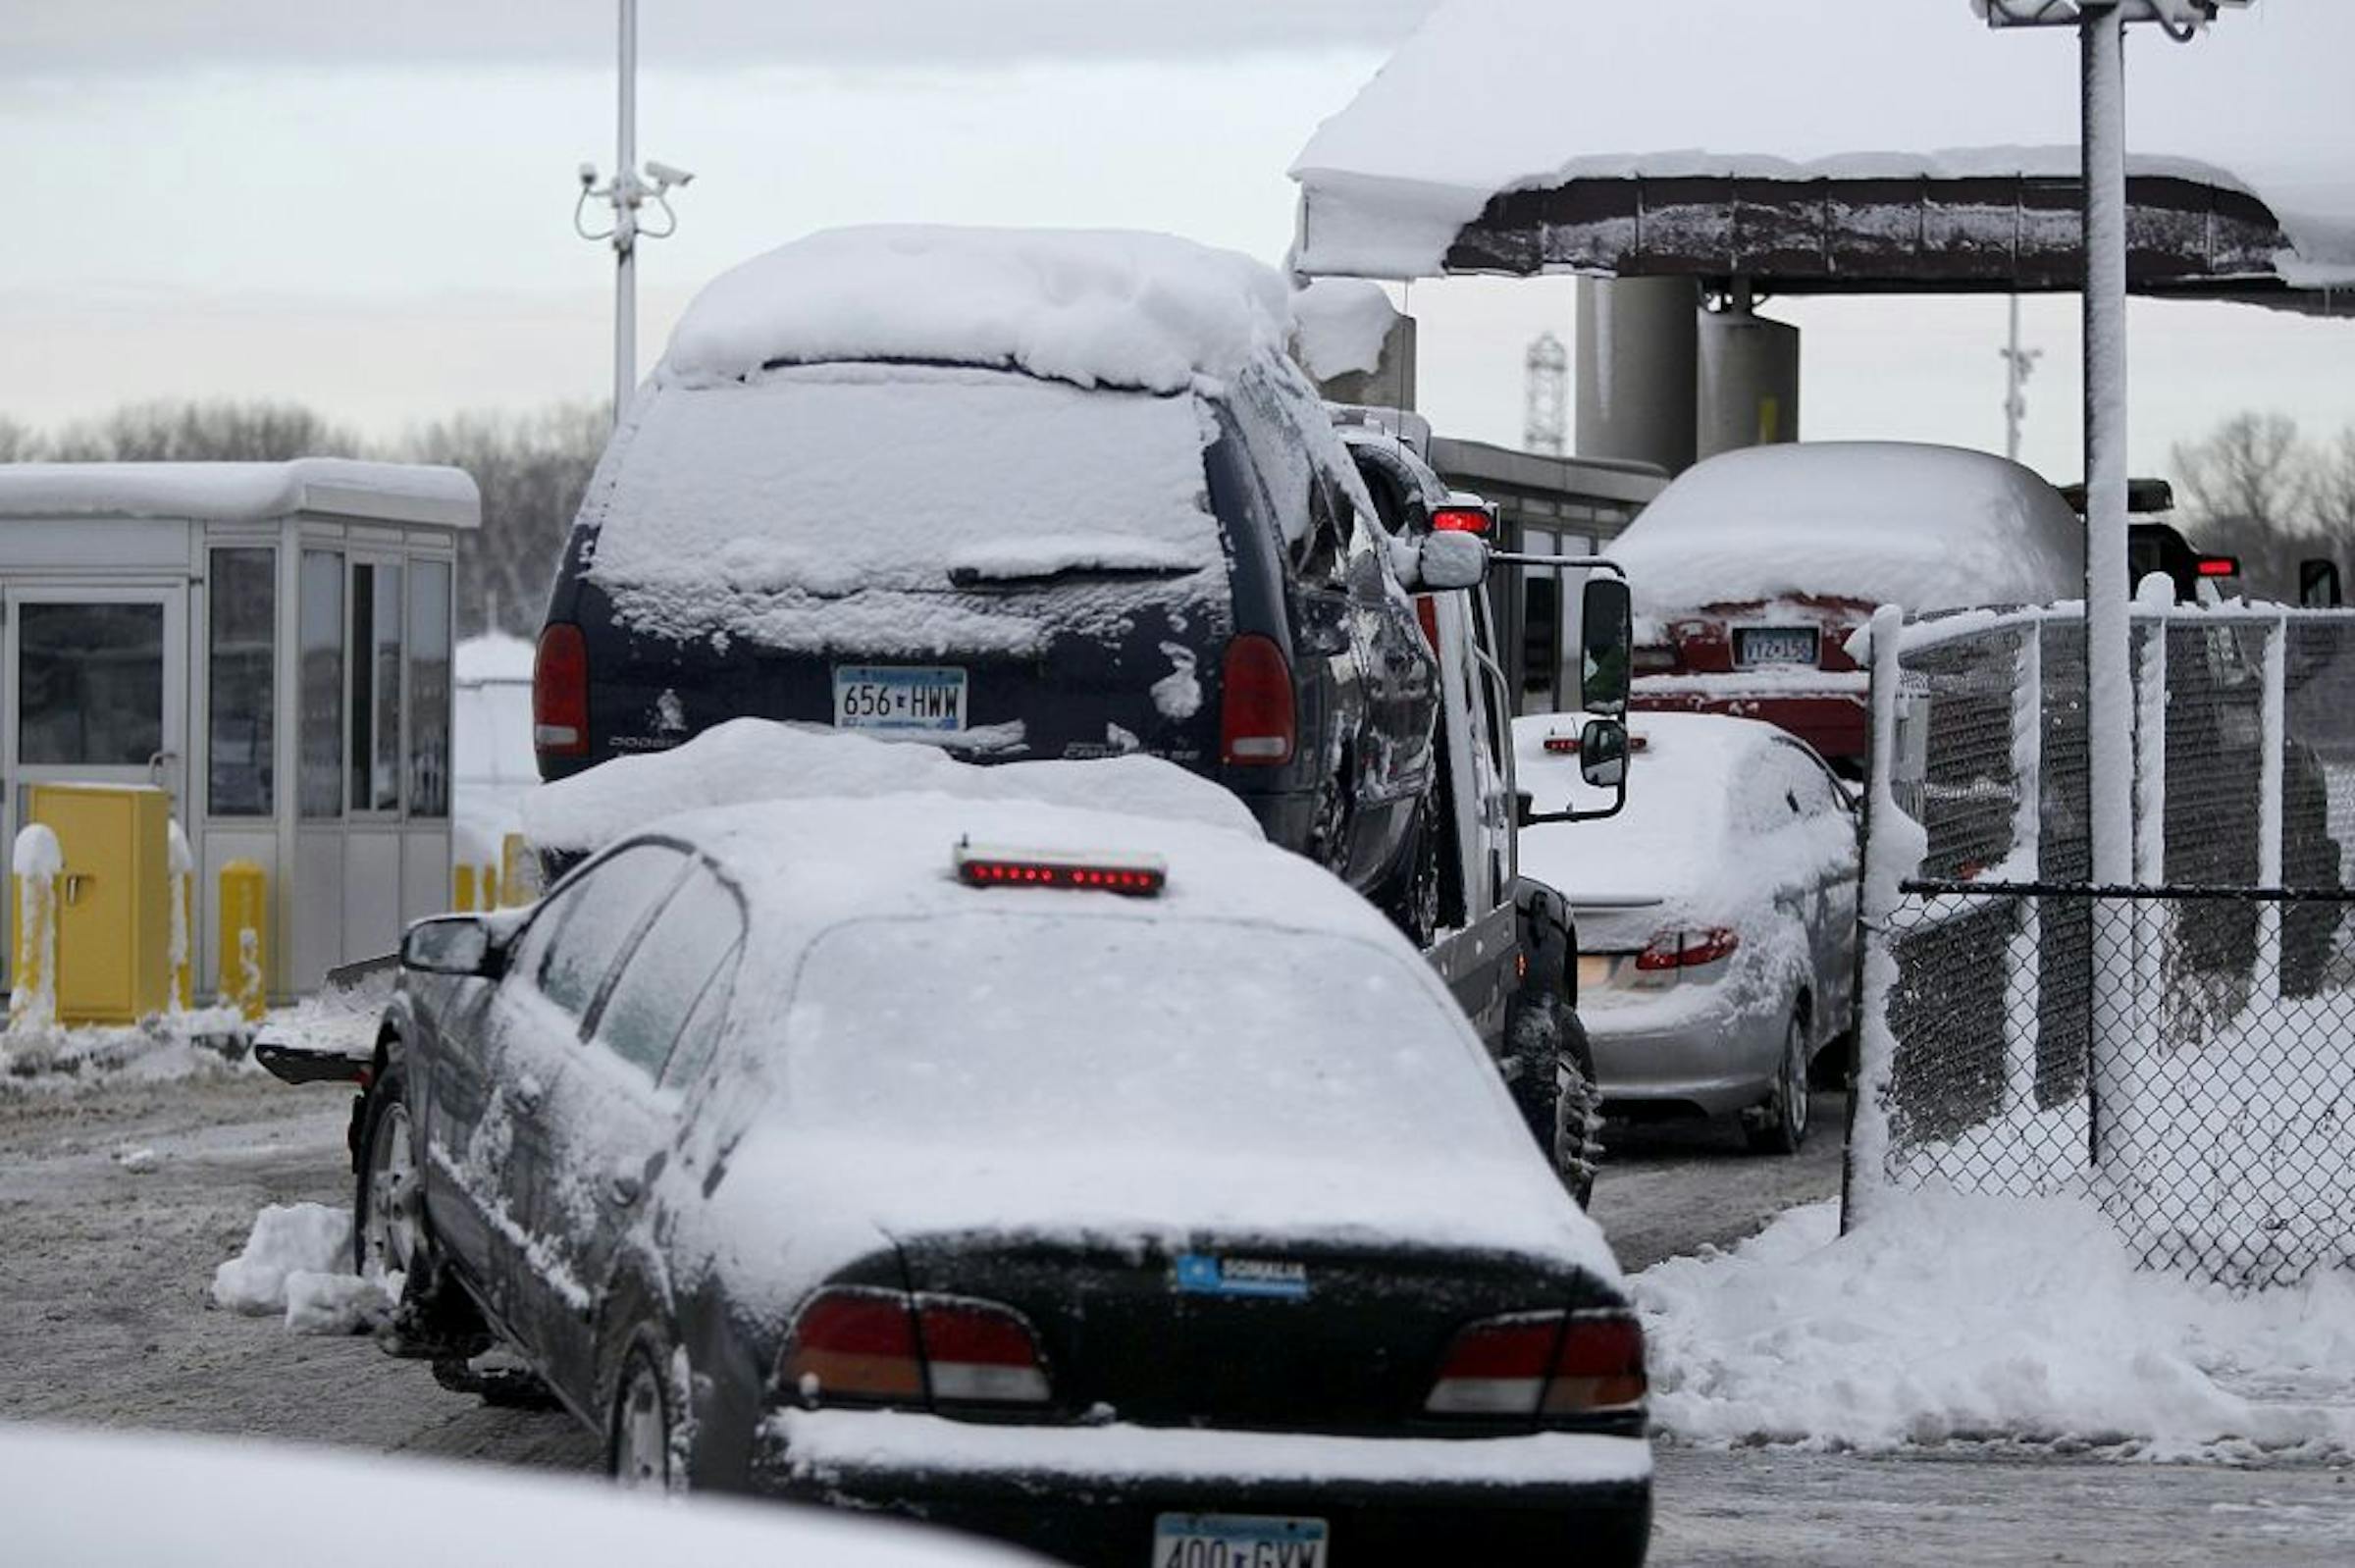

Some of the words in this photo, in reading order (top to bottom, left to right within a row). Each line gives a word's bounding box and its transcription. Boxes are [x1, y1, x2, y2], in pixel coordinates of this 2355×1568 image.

[844, 685, 891, 715] 656
[911, 685, 959, 717] HWW
[1166, 1538, 1229, 1568] 400
